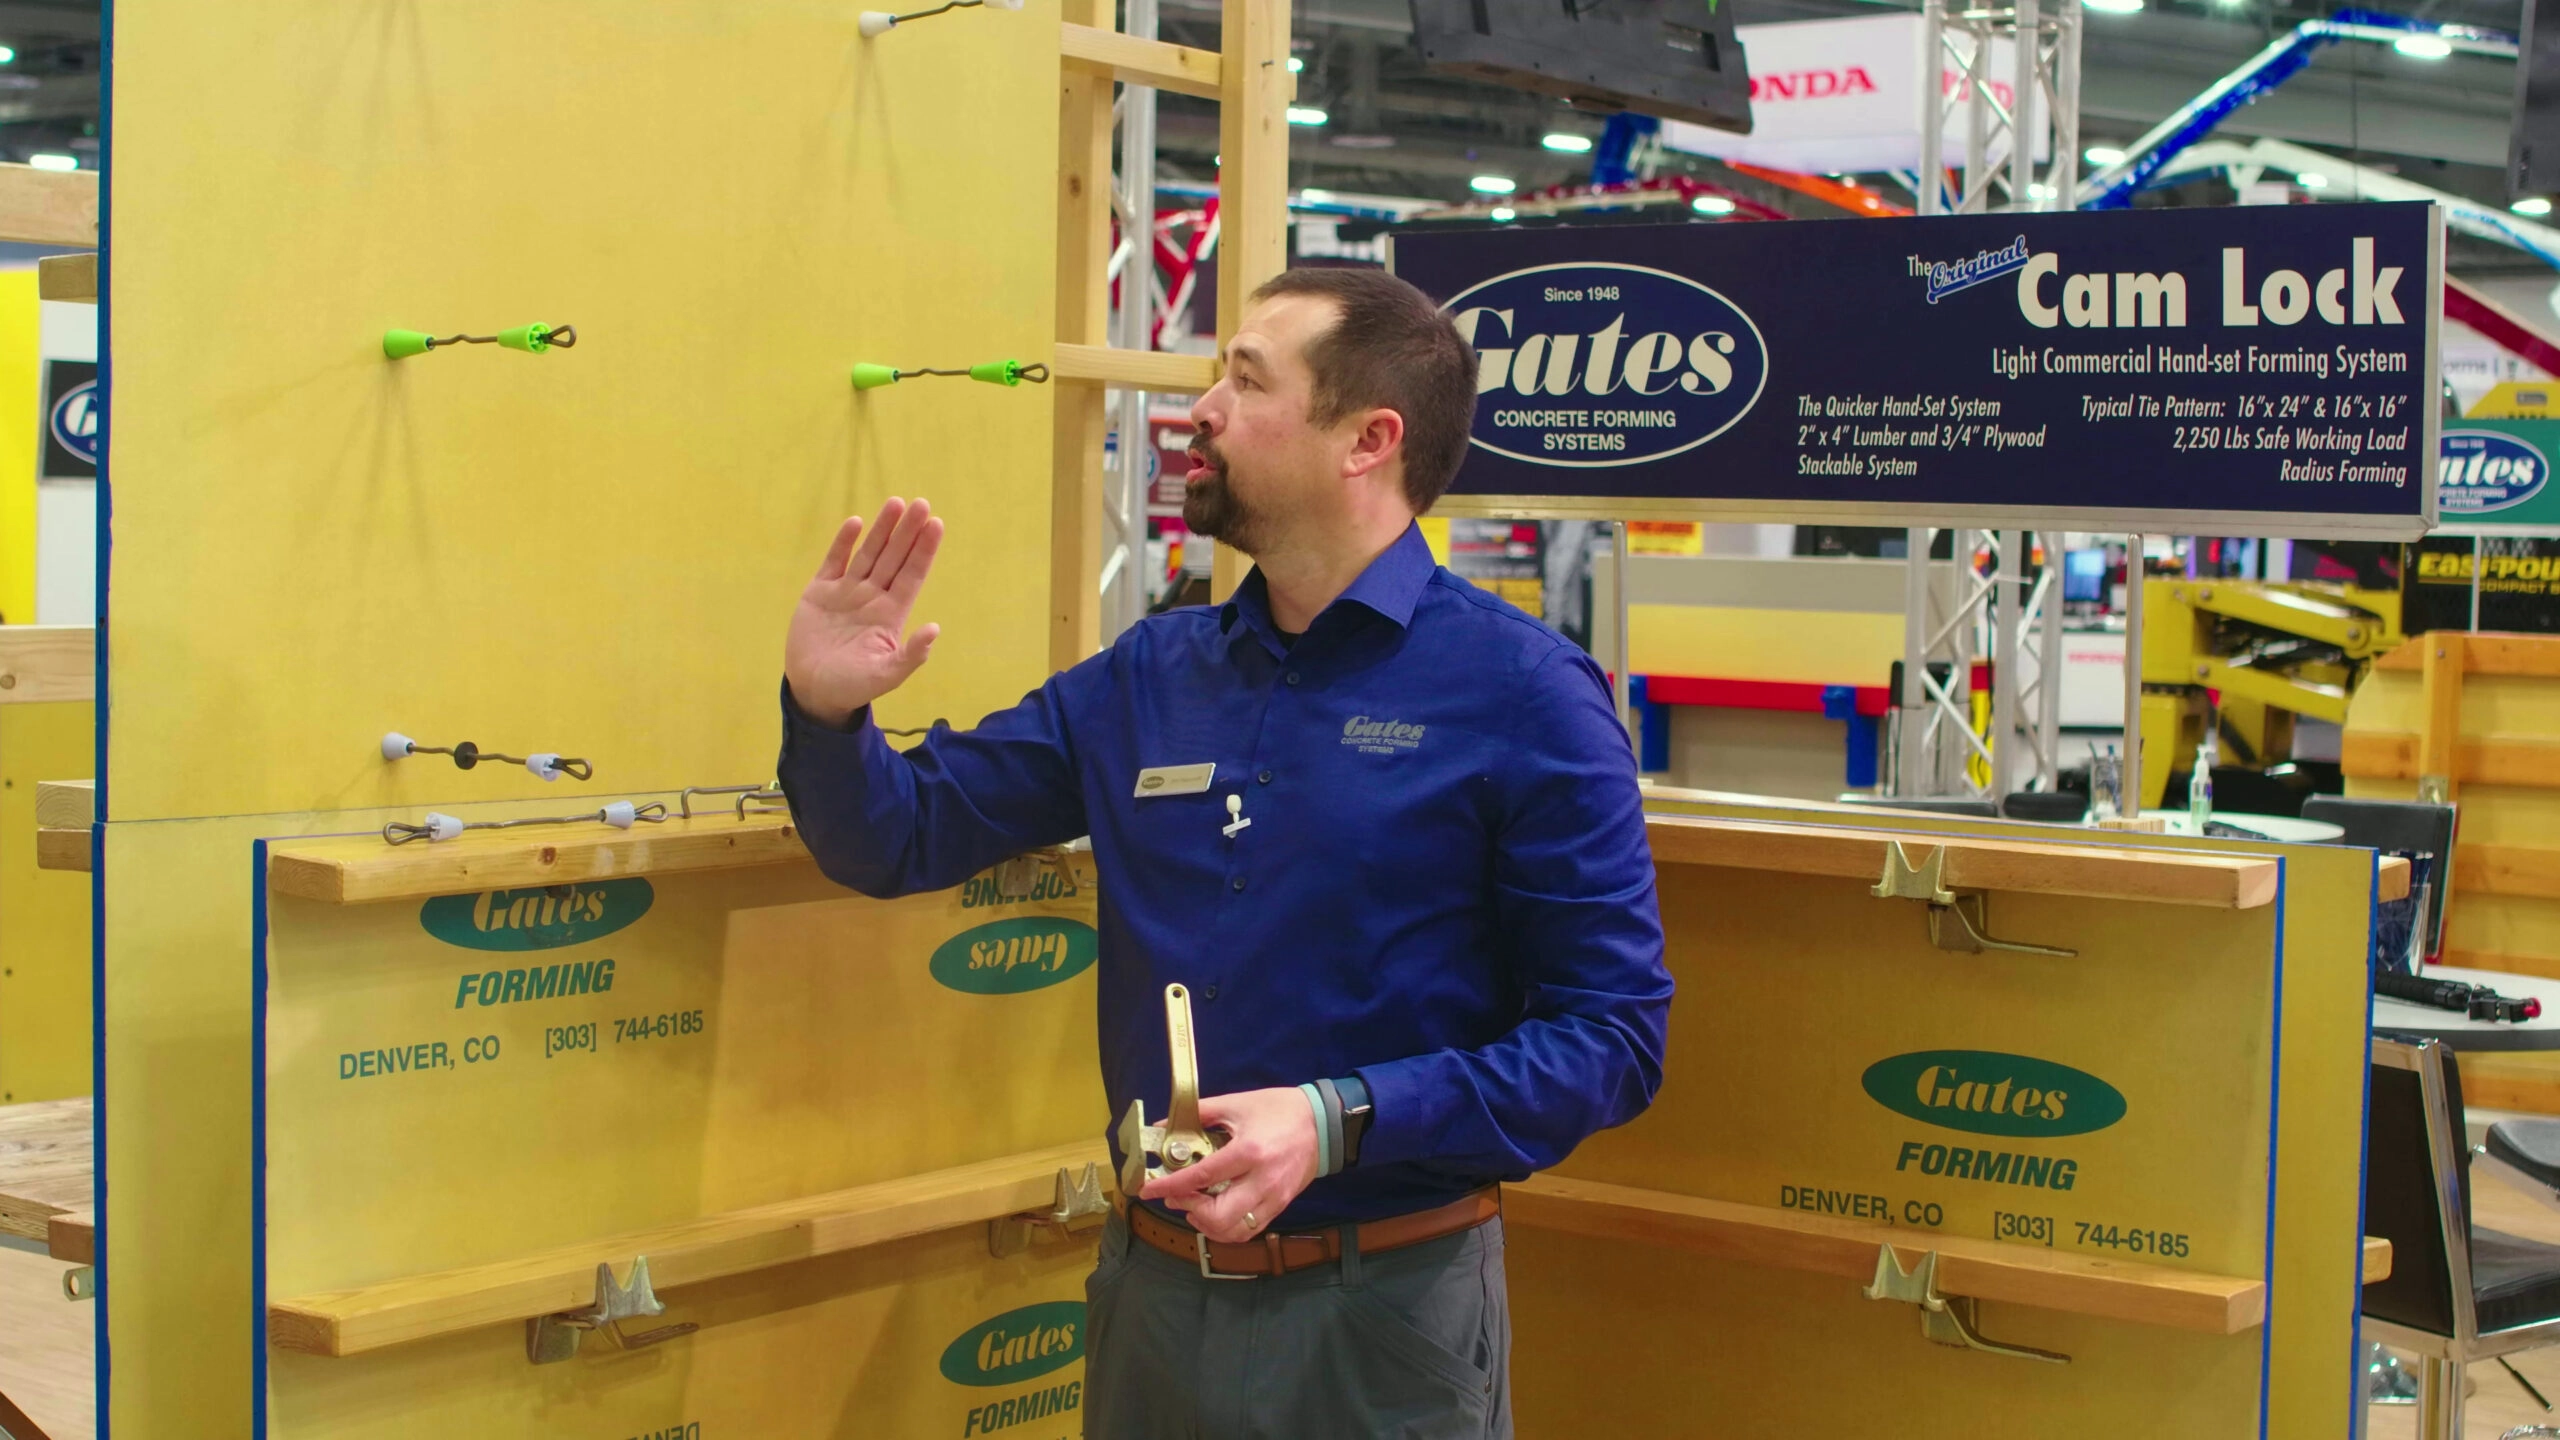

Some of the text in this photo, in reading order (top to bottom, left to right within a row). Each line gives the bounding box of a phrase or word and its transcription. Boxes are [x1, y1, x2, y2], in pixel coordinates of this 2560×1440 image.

[1748, 66, 1879, 101] NDA
[1907, 234, 2030, 301] The Original
[2017, 236, 2405, 329] Cam Lock
[1544, 286, 1620, 302] Since 1948
[1453, 306, 1736, 397] Gates
[1993, 345, 2408, 381] Light Commercial Hand-set Forming System
[1494, 410, 1677, 428] CONCRETE FORMING
[1798, 393, 2001, 421] The Quicker Hand-Set System
[2082, 393, 2134, 422] Typical
[2139, 395, 2159, 417] Tie
[2164, 396, 2226, 418] Pattern:
[2313, 397, 2326, 418] &
[1543, 433, 1626, 451] SYSTEMS
[1818, 430, 1828, 446] x
[1853, 424, 1907, 447] Lumber
[1910, 424, 1939, 447] and
[1984, 423, 2046, 451] Plywood
[2173, 425, 2408, 456] 2,250 Lbs Safe Working Load
[1798, 452, 1918, 480] Stackable System
[2280, 458, 2407, 488] Radius Forming
[2438, 450, 2536, 487] ates
[1343, 715, 1426, 740] Gates
[473, 888, 606, 932] Gates
[968, 932, 1068, 974] Gates
[455, 958, 615, 1009] FORMING
[340, 1009, 704, 1080] DENVER, CO [303] 744-6185
[1916, 1065, 2068, 1121] Gates
[1896, 1141, 2077, 1191] FORMING
[1781, 1184, 2190, 1258] DENVER, CO [303] 744-6185
[977, 1322, 1076, 1372] Gates
[964, 1381, 1081, 1439] FORMING
